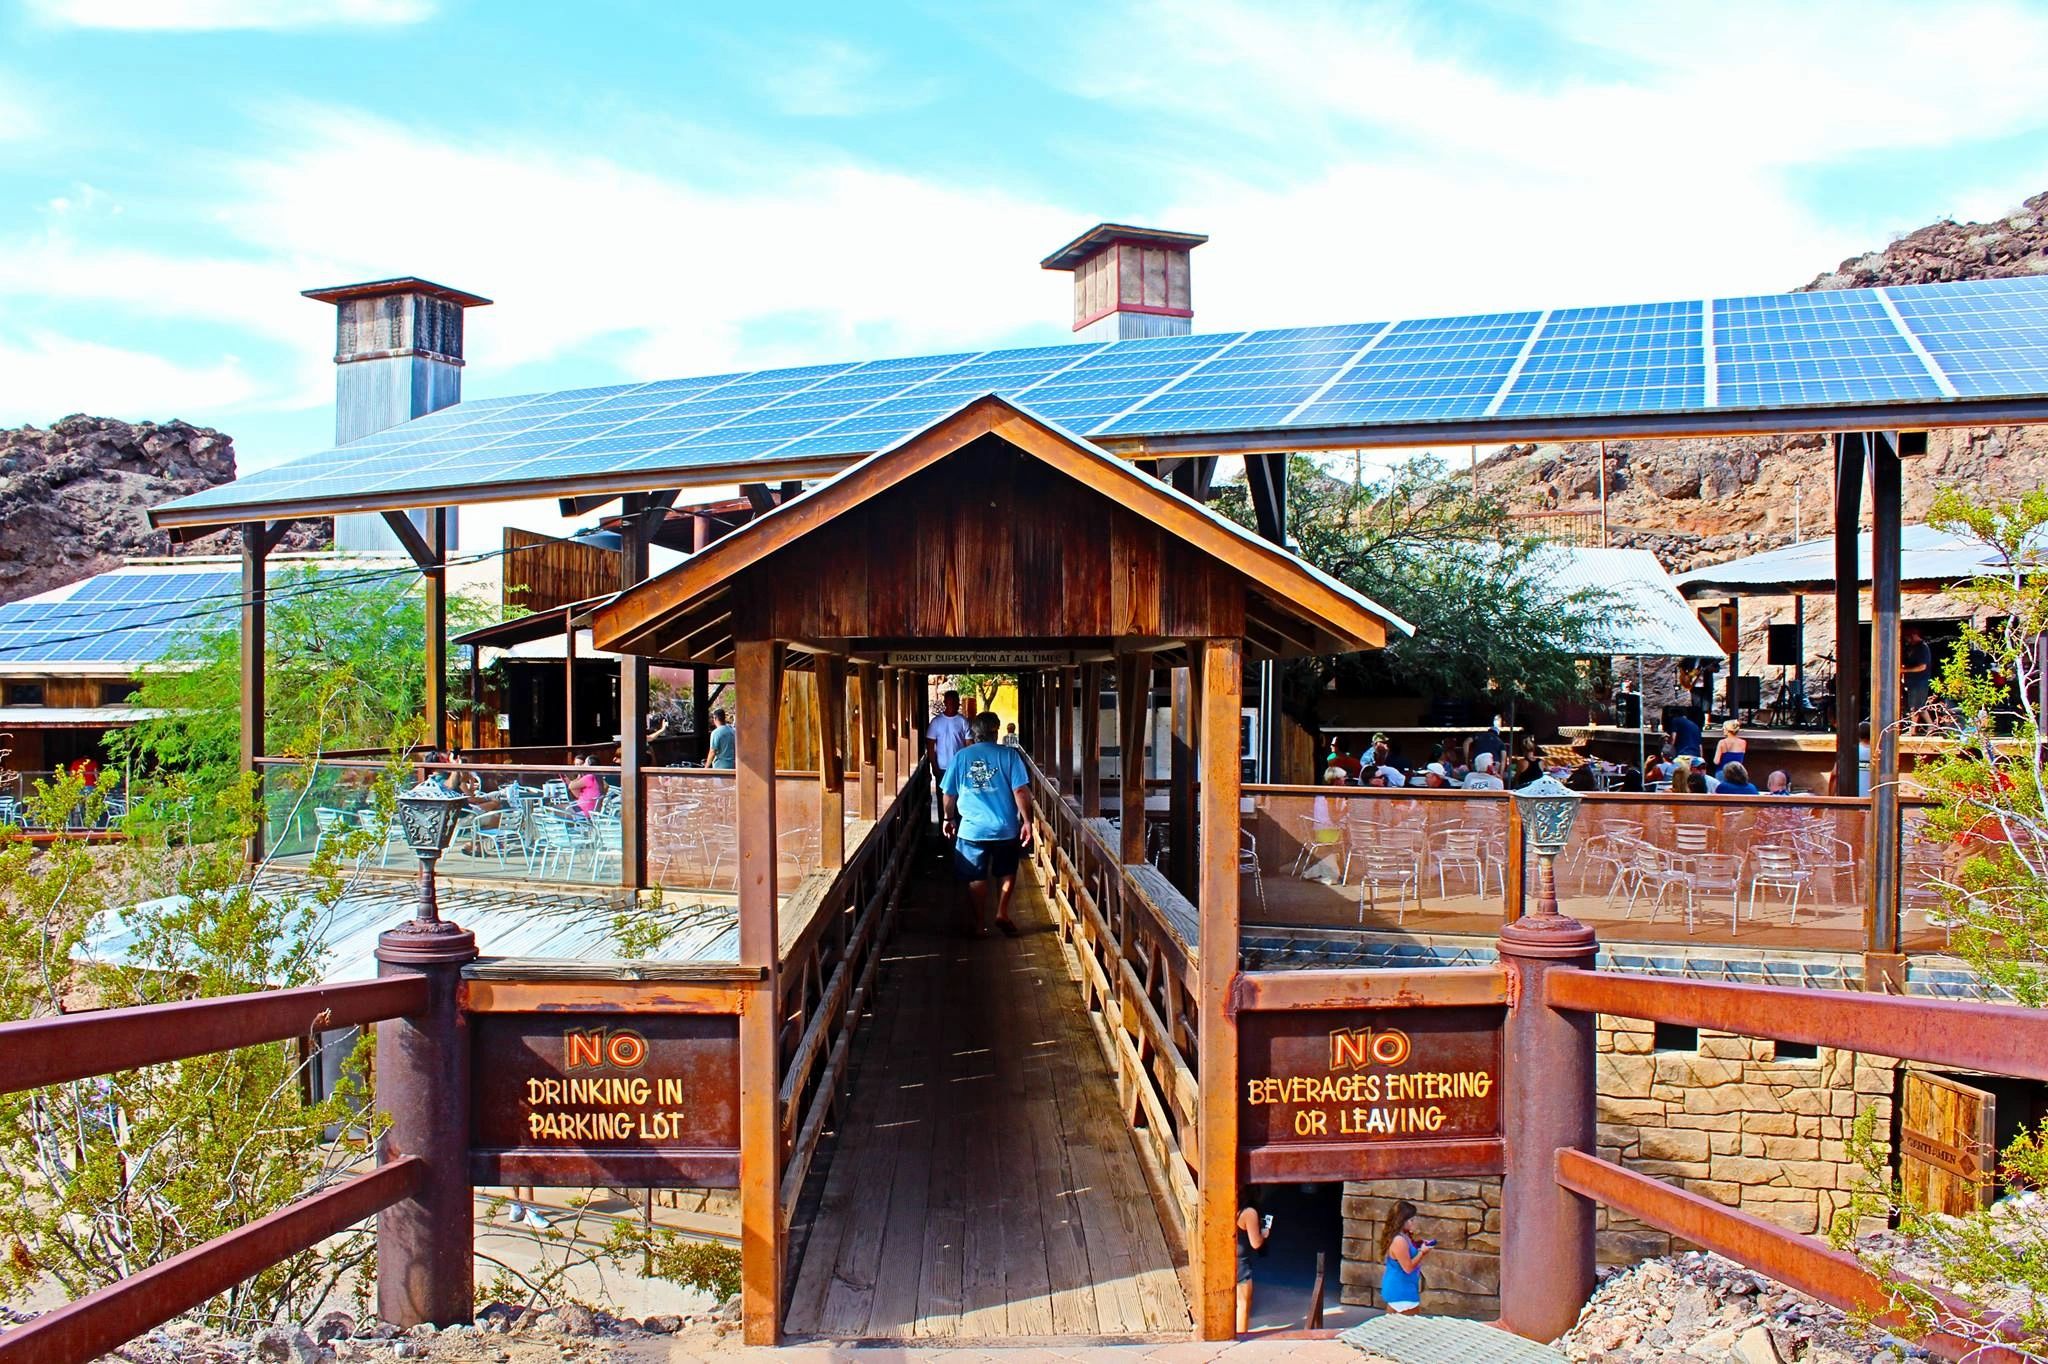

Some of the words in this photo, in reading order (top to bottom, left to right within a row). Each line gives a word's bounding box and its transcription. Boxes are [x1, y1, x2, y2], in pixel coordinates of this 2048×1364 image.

[896, 654, 932, 663] PARENT
[935, 654, 997, 663] SUPERVISION
[999, 654, 1010, 663] AT
[1014, 654, 1030, 663] ALL
[1032, 654, 1062, 663] TIMES
[565, 1027, 649, 1071] NO
[1329, 1027, 1411, 1071] NO
[526, 1077, 652, 1105] DRINKING
[658, 1078, 684, 1105] IN
[1247, 1074, 1380, 1105] BEVERAGES
[1386, 1071, 1493, 1100] ENTERING
[528, 1112, 636, 1141] PARKING
[639, 1111, 685, 1140] LOT
[1295, 1107, 1328, 1136] OR
[1340, 1106, 1447, 1134] LEAVING
